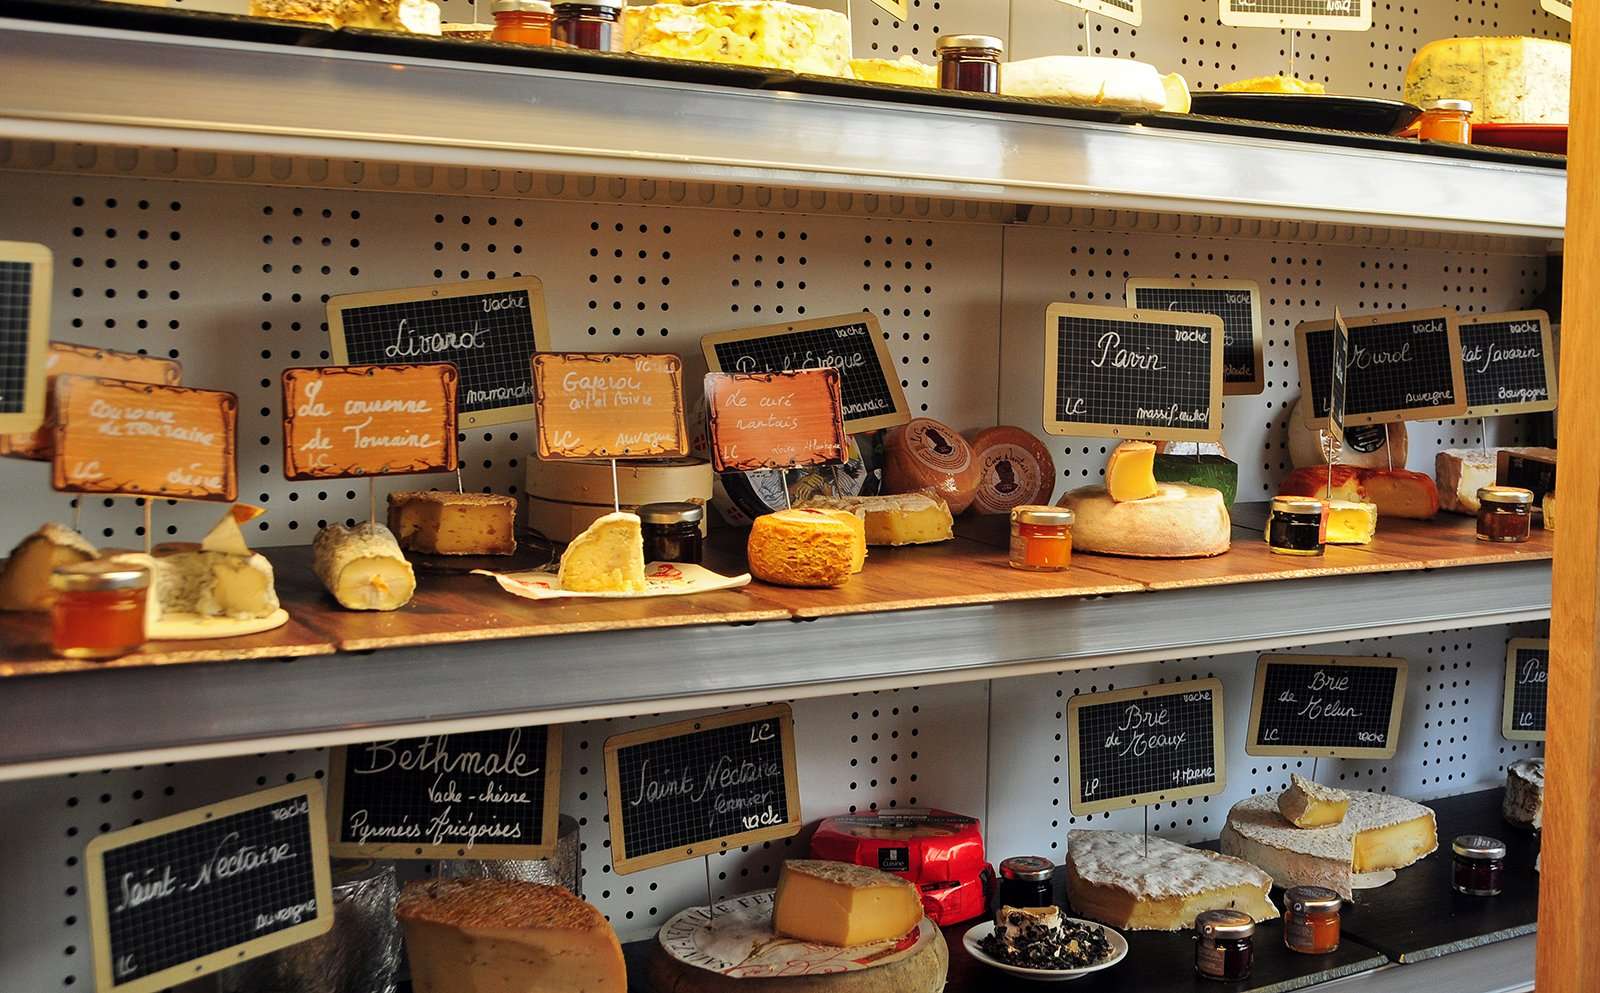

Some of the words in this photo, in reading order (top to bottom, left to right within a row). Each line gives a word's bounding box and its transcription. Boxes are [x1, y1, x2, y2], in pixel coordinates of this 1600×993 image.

[482, 297, 527, 313] vache
[834, 325, 866, 339] vache
[1175, 329, 1209, 344] vache
[1412, 322, 1444, 334] vache
[1509, 323, 1540, 334] vache
[385, 319, 490, 357] Livarot
[1091, 331, 1167, 371] Pavin
[759, 393, 795, 408] curé
[1064, 397, 1089, 416] LC
[735, 414, 801, 431] nantais
[300, 427, 334, 451] de
[1307, 670, 1350, 691] Brie
[1519, 658, 1548, 684] Pie
[1278, 689, 1298, 703] de
[1118, 704, 1170, 732] Brie
[1519, 712, 1534, 727] LC
[750, 723, 775, 744] LC
[1104, 730, 1122, 749] de
[1263, 728, 1280, 742] LC
[354, 727, 540, 777] Bethmale
[1084, 778, 1099, 797] LP
[118, 953, 138, 976] LC
